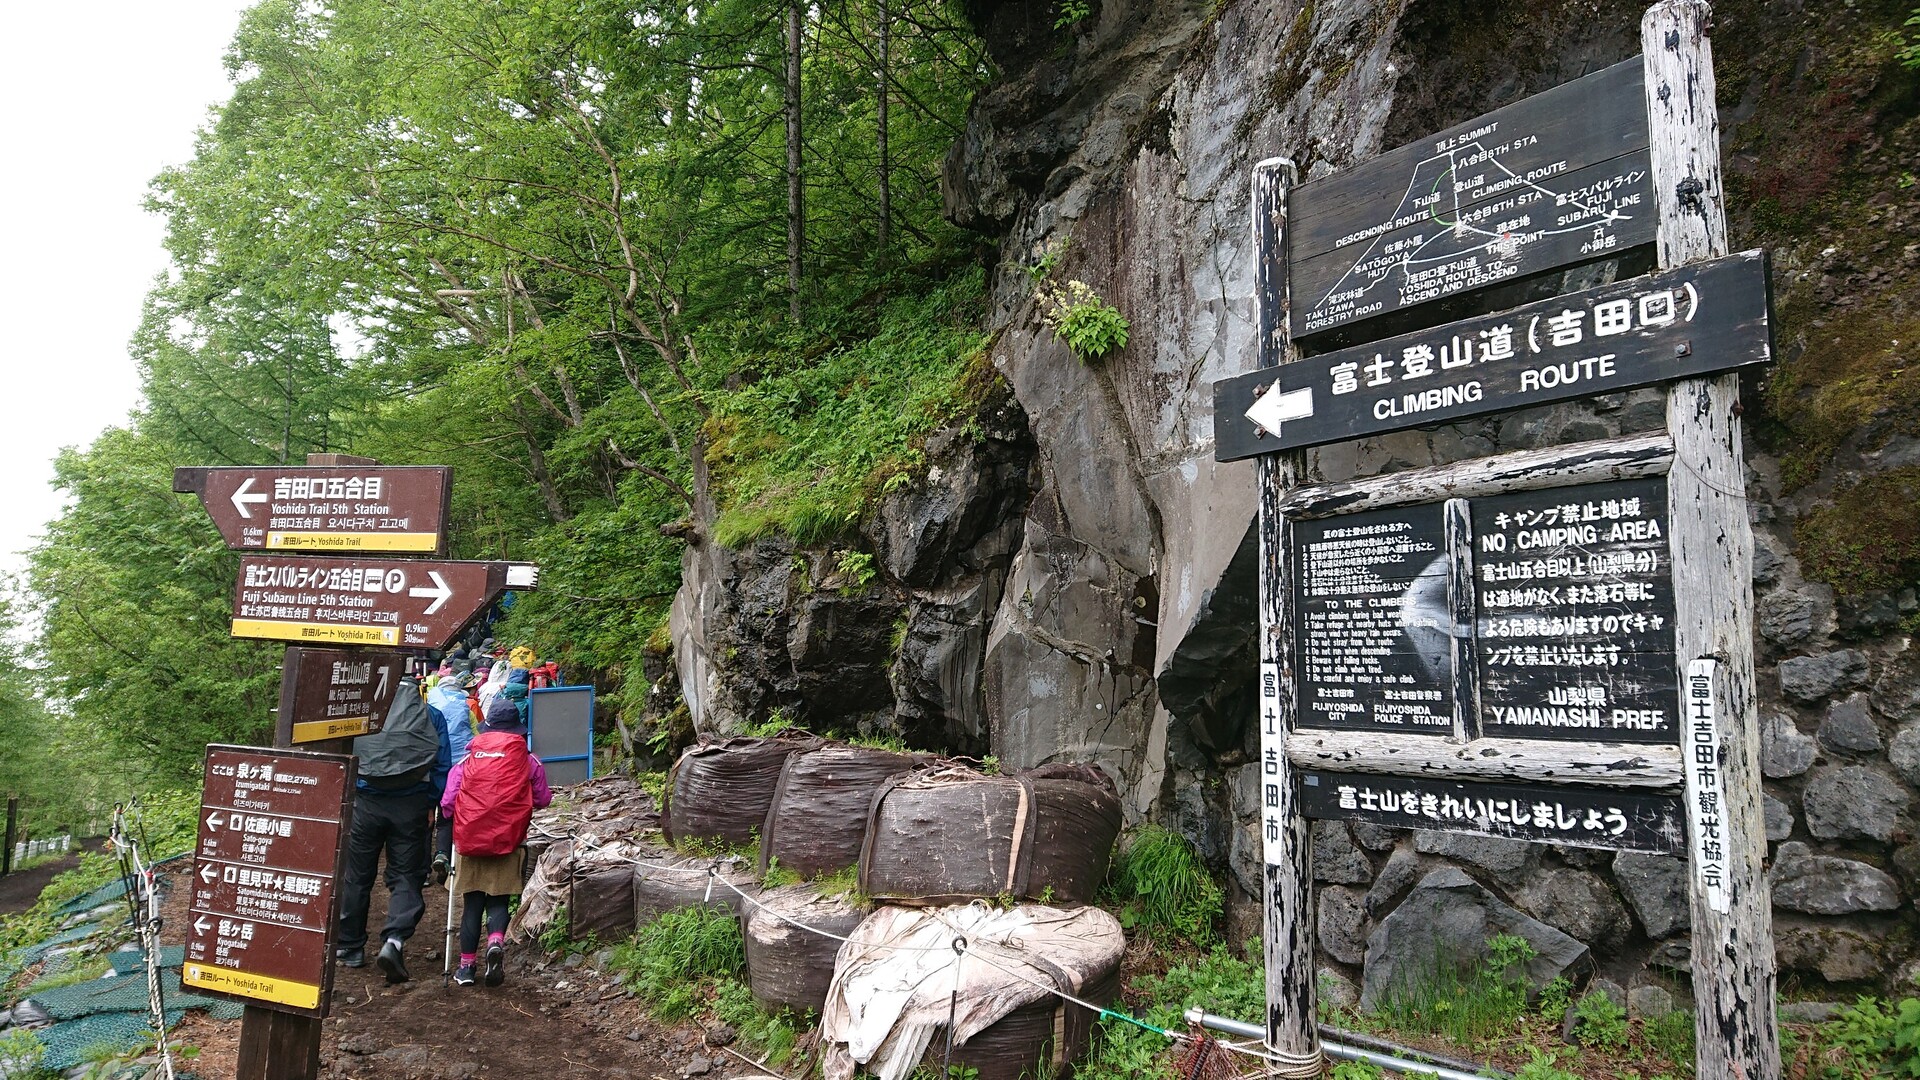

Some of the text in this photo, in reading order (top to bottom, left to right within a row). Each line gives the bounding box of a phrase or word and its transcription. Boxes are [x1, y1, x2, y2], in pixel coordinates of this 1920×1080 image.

[1436, 122, 1499, 153] 頂上 SUMMIT
[1514, 135, 1538, 149] STA
[1453, 174, 1485, 193] 登山道
[1472, 161, 1567, 199] CLIMBING ROUTE
[1555, 170, 1646, 207] 富士スバルライン
[1412, 191, 1441, 209] 下山道
[1518, 191, 1543, 206] STA
[1587, 192, 1613, 207] FUJI
[1557, 193, 1641, 226] SUBARU LINE
[1335, 210, 1429, 248] DESCENDING ROUTE
[1496, 215, 1531, 234] 現在地
[1384, 234, 1423, 254] 佐藤小屋
[1486, 230, 1545, 255] THIS POINT
[1580, 235, 1616, 254] 小御岳
[1367, 267, 1386, 279] HUT
[1399, 260, 1503, 296] YOSHIDA ROUTE TO
[1409, 256, 1478, 284] 吉田口登下山道
[1399, 266, 1518, 306] ASCEND AND DESCEND
[1328, 287, 1364, 305] 滝沢林道
[1305, 301, 1383, 331] FORESTRY ROAD
[1373, 354, 1617, 421] CLIMBING ROUTE
[274, 477, 382, 500] 吉田口五合目
[272, 503, 389, 515] Yoshida Trail 5th Station
[1495, 497, 1641, 529] キャンプ禁止地域
[243, 527, 263, 536] 0.6km
[269, 517, 408, 530] 吉田口五合目 요시다구치 고고메
[283, 537, 361, 546] 吉田ルート Yoshida Trail
[1482, 519, 1661, 552] NO CAMPING AREA
[1303, 553, 1308, 561] 2
[1303, 562, 1308, 570] 3
[1303, 570, 1308, 578] 4
[244, 565, 362, 592] 富士スバルライン五合目
[1303, 579, 1308, 587] 5
[242, 591, 373, 608] Fuji Subaru Line 5th Station
[1303, 588, 1309, 597] 6
[1483, 582, 1655, 607] は適地がなく、また落石等に
[1325, 597, 1417, 608] TO THE CLIMBERS
[315, 608, 370, 623] 후지스바루라인
[372, 611, 398, 625] 고고메
[1310, 612, 1325, 620] Avoid
[1352, 611, 1369, 620] during
[1372, 610, 1384, 619] bad
[405, 623, 428, 633] 0.9km
[1310, 621, 1324, 629] Take
[1326, 621, 1344, 629] refuge
[1347, 621, 1353, 629] at
[1356, 620, 1375, 629] nearby
[1378, 620, 1391, 628] huts
[1485, 614, 1664, 638] よる危険もありますのでキャ
[302, 628, 381, 641] 吉田ルート Yoshida Trail
[1310, 630, 1327, 638] strong
[1369, 629, 1380, 637] rain
[1333, 638, 1348, 647] stray
[1350, 638, 1363, 646] from
[1365, 637, 1375, 646] the
[1305, 647, 1309, 655] 4
[1311, 647, 1319, 655] Do
[1321, 647, 1331, 655] not
[1344, 647, 1359, 655] when
[1486, 644, 1629, 666] ンプを禁止いたします。
[1305, 656, 1360, 665] 5 Beware of falling
[1306, 665, 1310, 673] 6
[1313, 665, 1320, 673] Do
[1323, 665, 1332, 673] not
[1334, 665, 1348, 673] climb
[1351, 665, 1365, 673] when
[1306, 674, 1310, 682] 7
[1313, 674, 1321, 682] Be
[1323, 674, 1341, 682] careful
[1345, 674, 1355, 683] and
[1357, 674, 1373, 684] enjoy
[1383, 675, 1396, 683] safe
[1317, 688, 1355, 698] 富士吉田市
[1549, 687, 1607, 707] 山梨県
[1312, 702, 1365, 713] FUJIYOSHIDA
[1374, 705, 1431, 715] FUJIYOSHIDA
[1328, 712, 1346, 721] CITY
[1374, 714, 1450, 726] POLICE STATION
[1492, 706, 1669, 730] YAMANASHI PREF.
[1263, 671, 1279, 844] 富士吉田市
[212, 765, 234, 776] ここは
[235, 780, 270, 791] Izumigataki
[1690, 674, 1722, 889] 富士吉田市観光協会
[1338, 785, 1628, 835] 富士山をきれいにしましょう
[245, 816, 292, 838] 佐藤小屋
[242, 833, 273, 845] Sato-goya
[217, 937, 248, 950] Kyogatake
[200, 971, 274, 994] 吉田ルート Yoshida Trail
